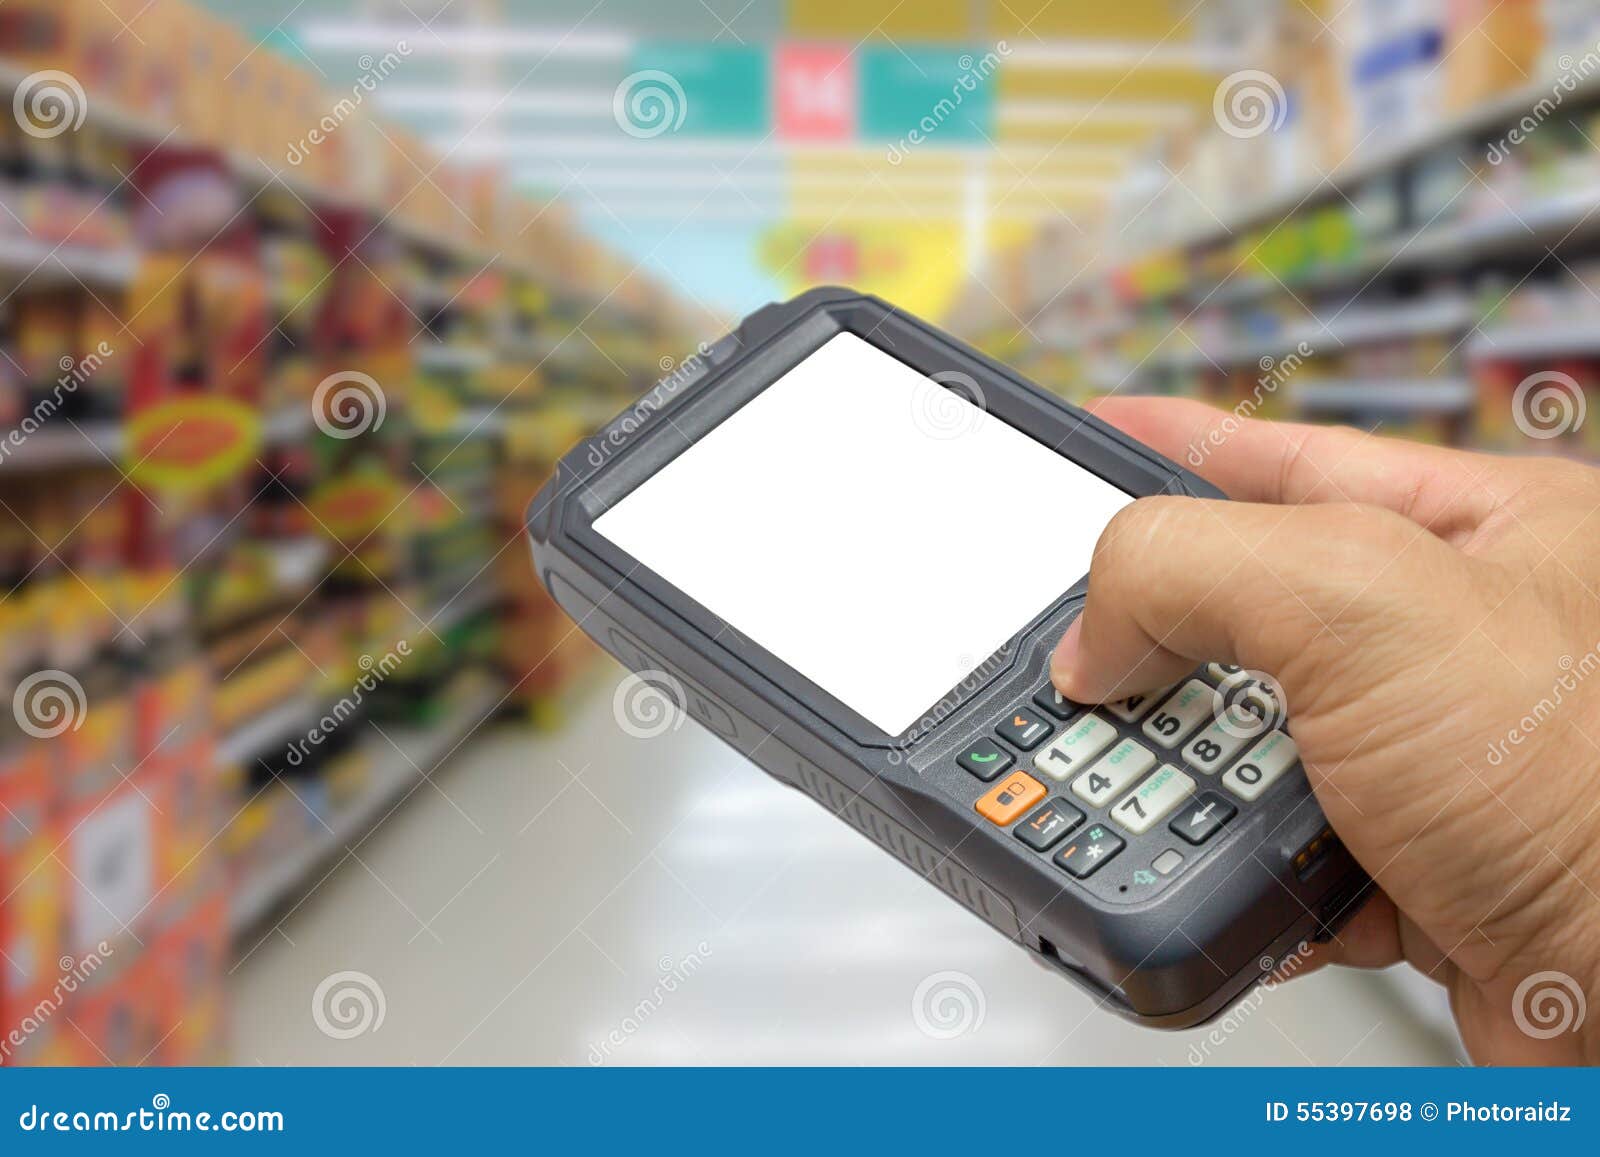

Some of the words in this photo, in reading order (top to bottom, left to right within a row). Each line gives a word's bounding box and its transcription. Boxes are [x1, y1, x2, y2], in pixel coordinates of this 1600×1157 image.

[1151, 711, 1181, 737] 5
[1048, 747, 1073, 765] 1
[1192, 738, 1222, 763] 8
[1088, 772, 1113, 795] 4
[1108, 742, 1135, 765] GHI
[1235, 763, 1263, 785] 0
[1120, 796, 1148, 818] 7
